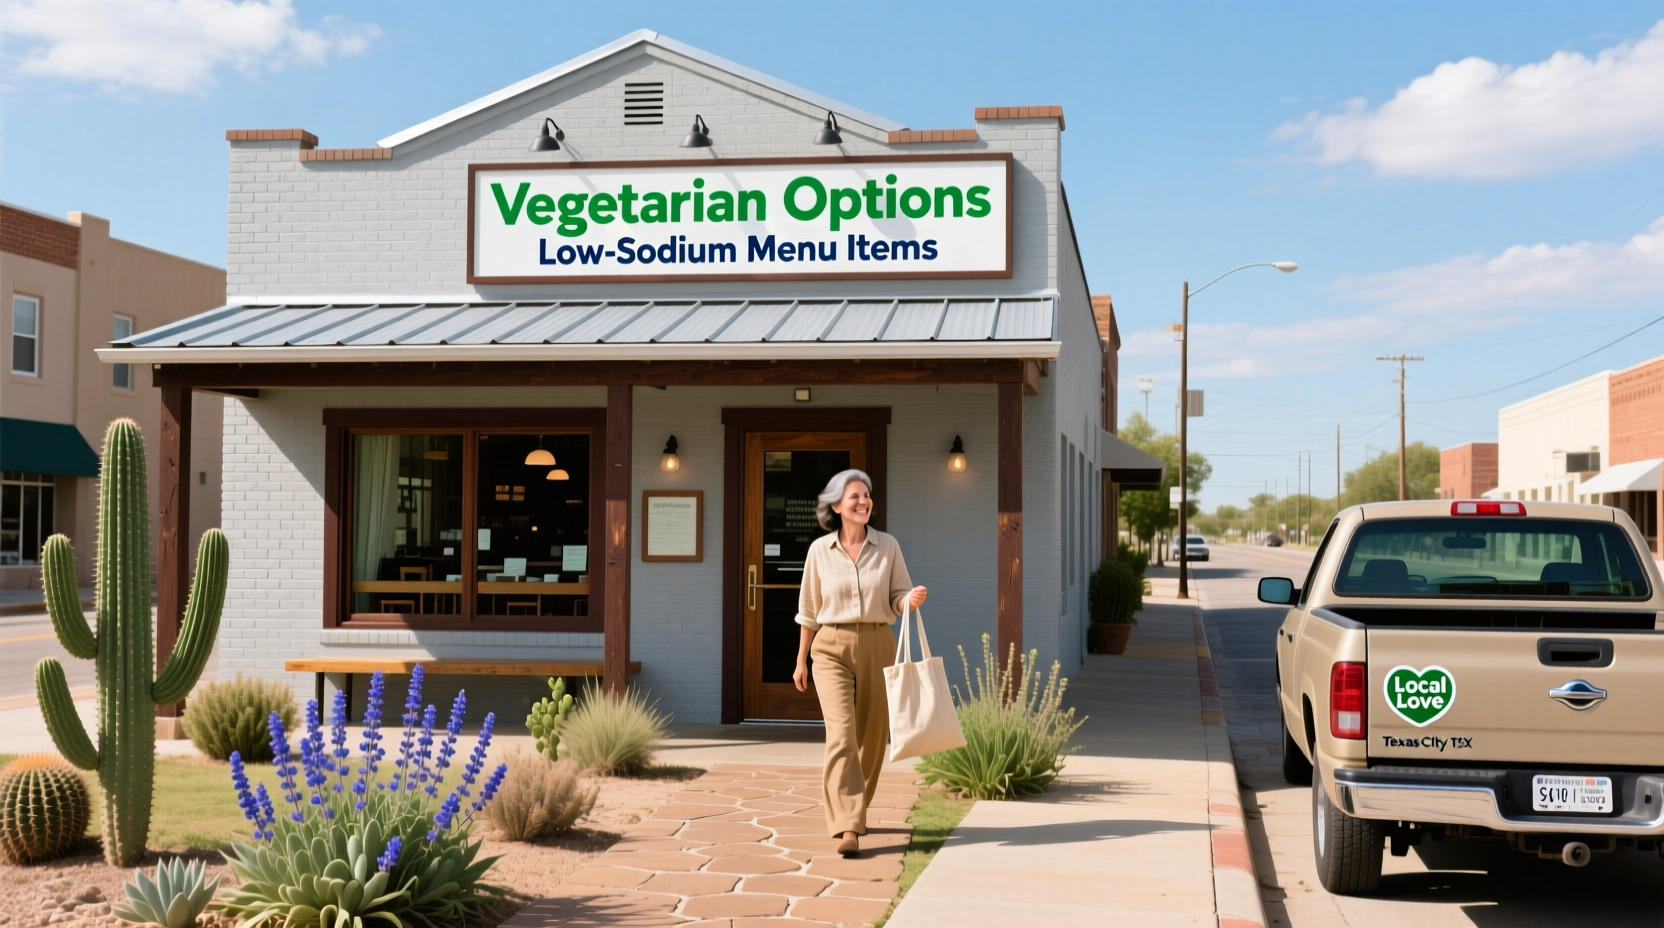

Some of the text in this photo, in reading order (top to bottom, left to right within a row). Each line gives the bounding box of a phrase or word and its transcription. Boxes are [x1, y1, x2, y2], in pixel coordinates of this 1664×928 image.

[490, 173, 993, 238] Vegetarian Options
[539, 233, 939, 266] Low-Sodium Menu Items
[1394, 675, 1447, 694] Local
[1396, 692, 1445, 710] Love
[1382, 736, 1420, 748] Texas
